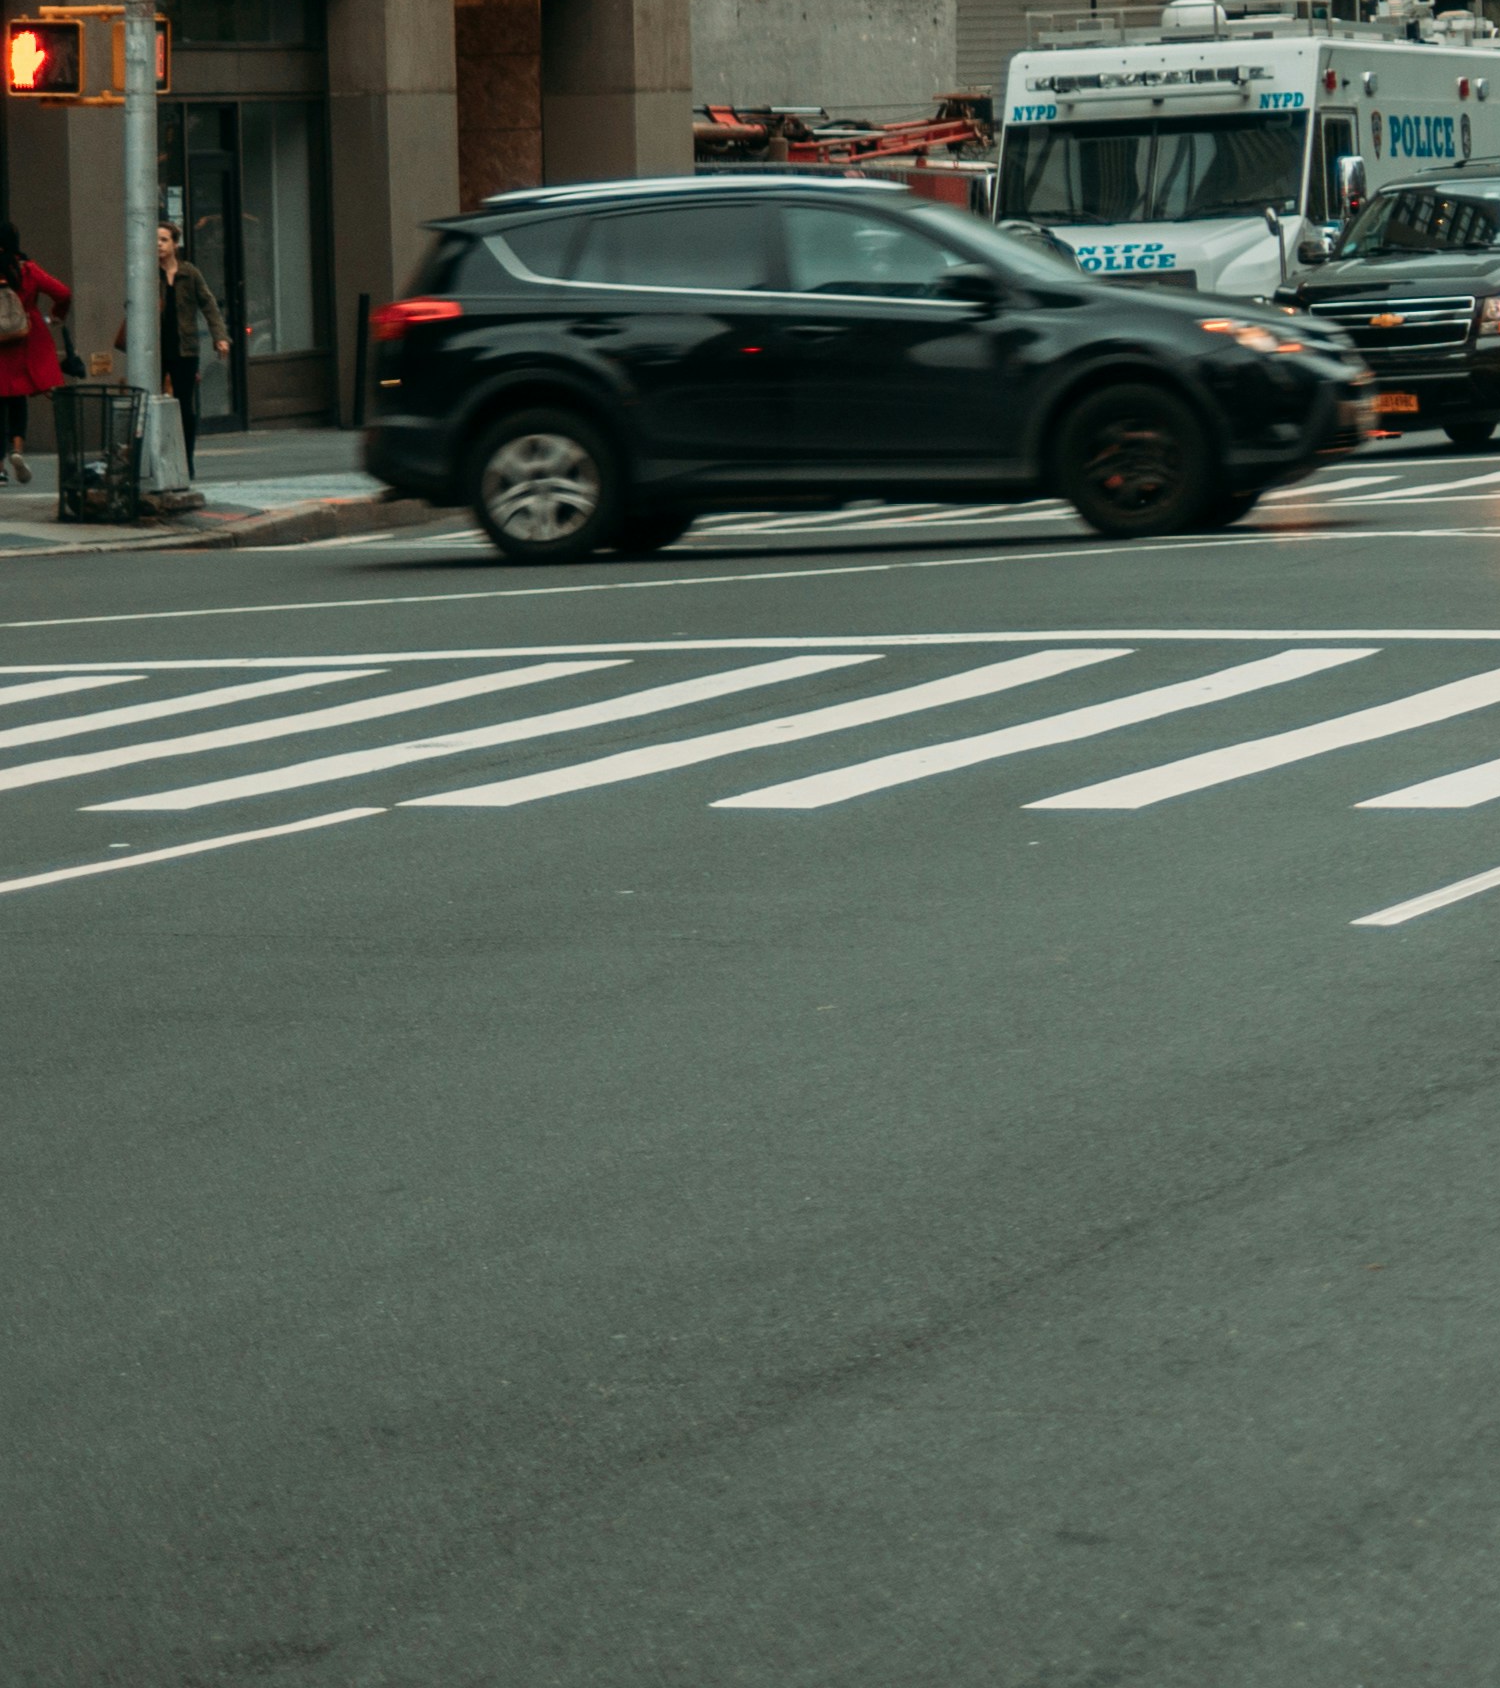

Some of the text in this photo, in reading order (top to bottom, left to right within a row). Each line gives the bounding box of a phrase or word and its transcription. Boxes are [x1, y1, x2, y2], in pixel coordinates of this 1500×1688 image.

[1260, 92, 1304, 110] NYPD
[1013, 104, 1057, 122] NYPD
[1388, 115, 1456, 158] POLICE
[1077, 242, 1164, 256] NYPD
[1080, 253, 1176, 272] OLICE
